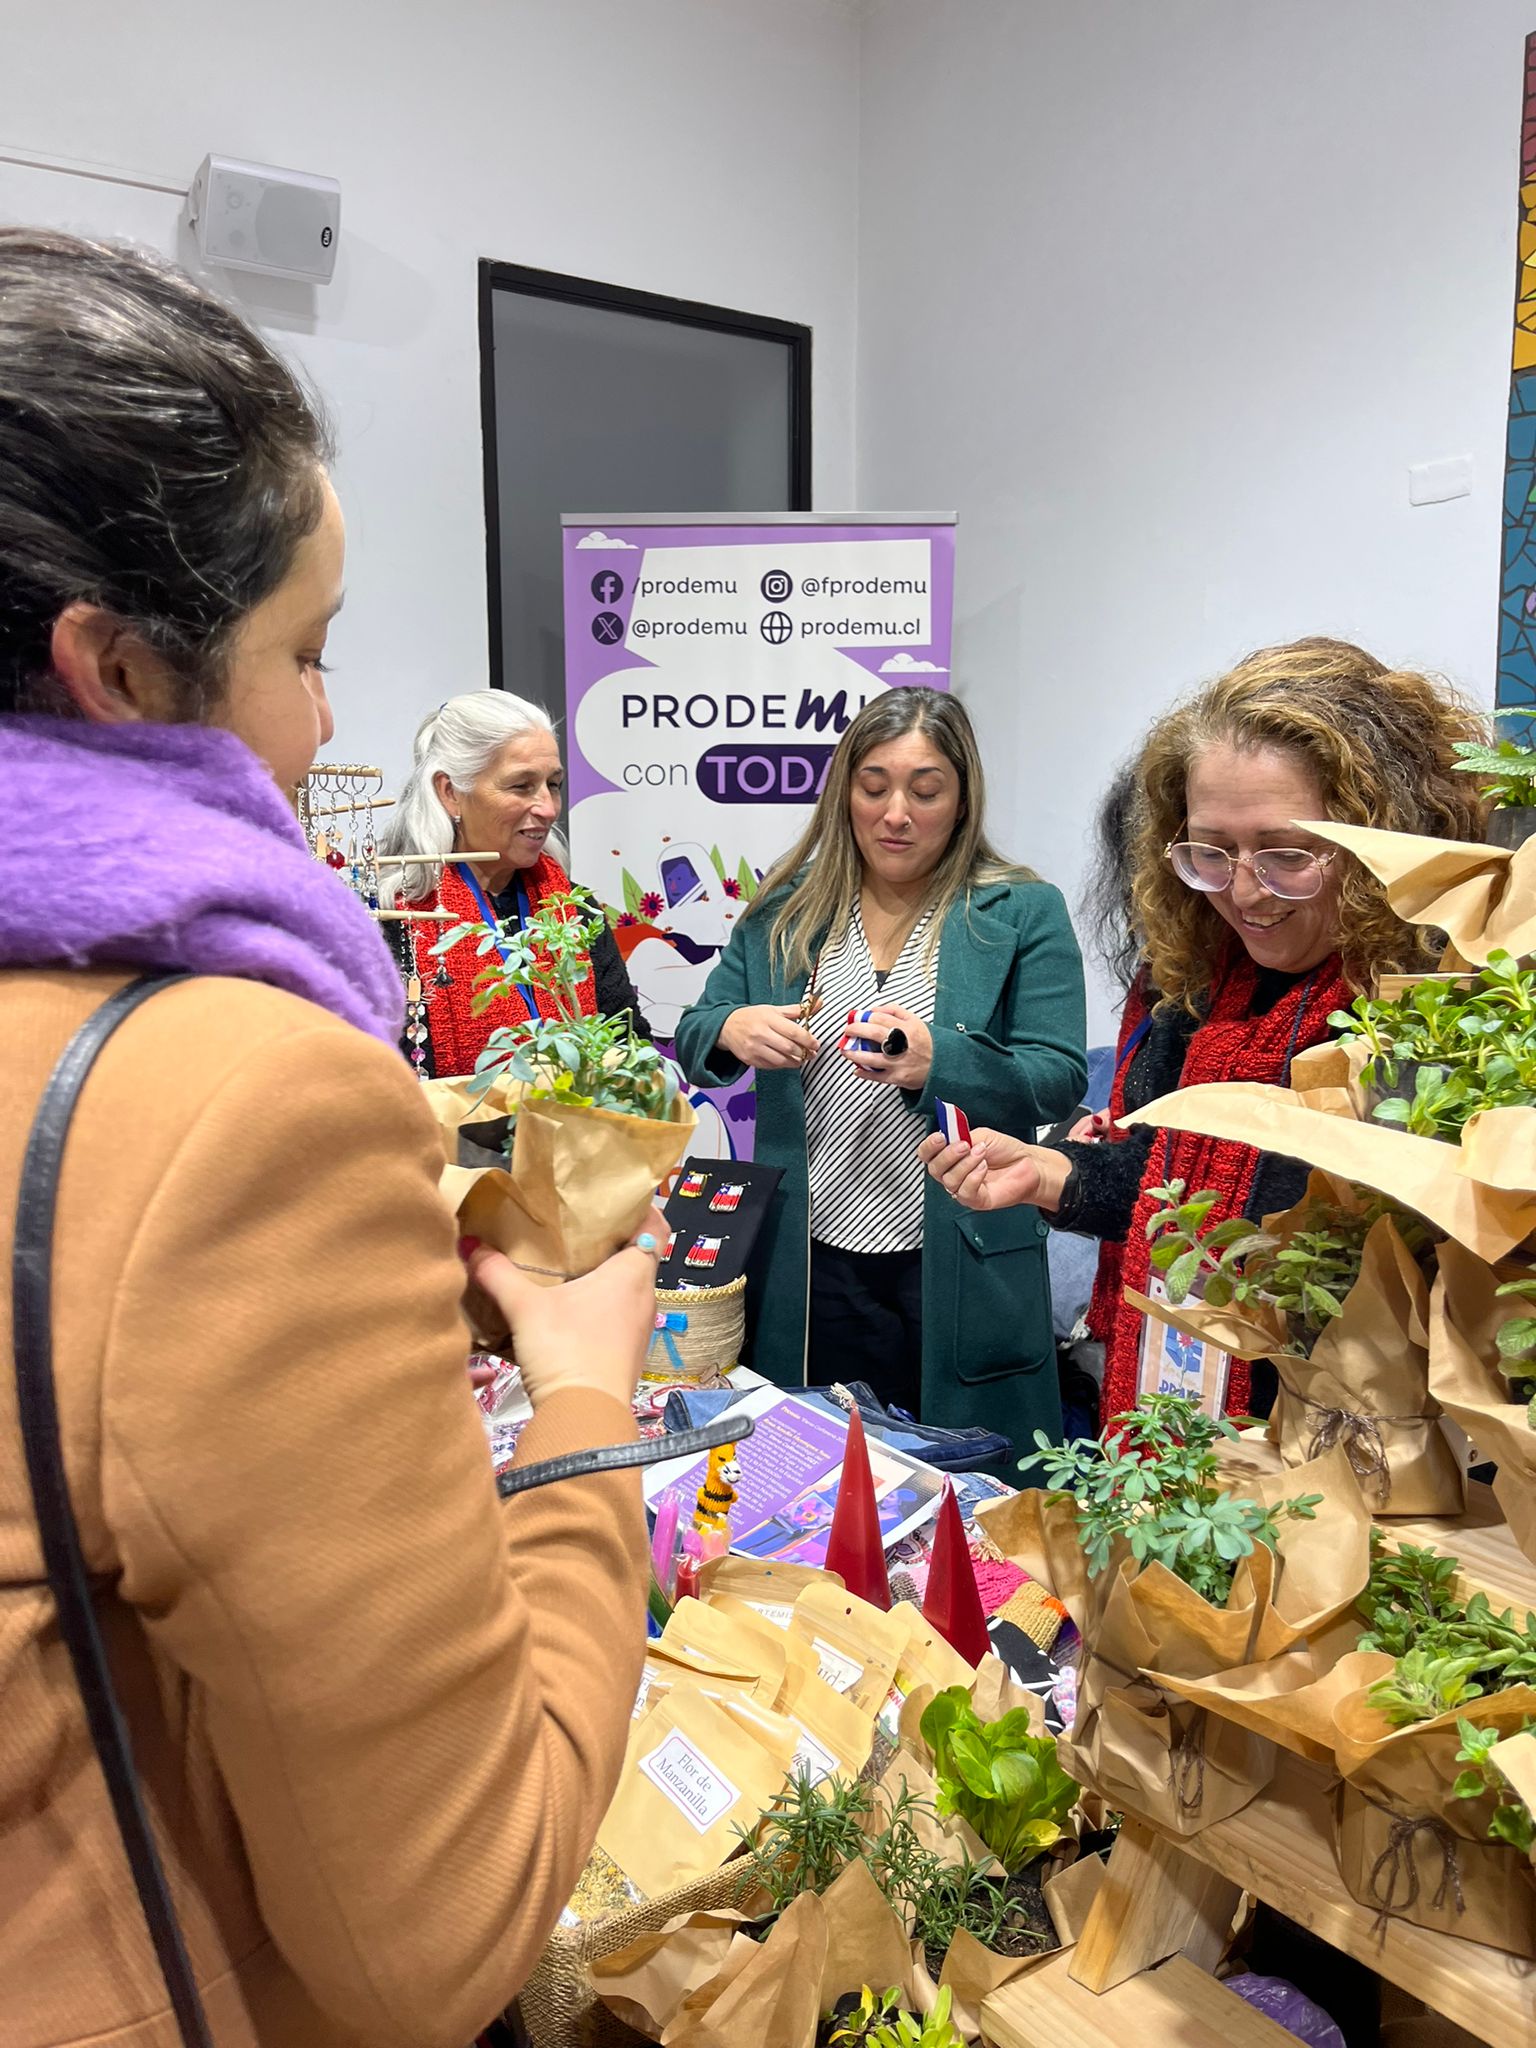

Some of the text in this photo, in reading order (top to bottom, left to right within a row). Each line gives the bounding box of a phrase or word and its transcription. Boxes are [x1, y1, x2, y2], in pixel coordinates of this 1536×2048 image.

[632, 576, 737, 598] /prodemu
[801, 576, 927, 598] @fprodemu
[632, 618, 747, 639] @prodemu
[801, 618, 920, 639] prodemu.cl
[622, 688, 866, 733] PRODEM
[623, 763, 688, 785] con
[678, 1753, 712, 1792] Flor de
[657, 1757, 708, 1816] Manzanilla
